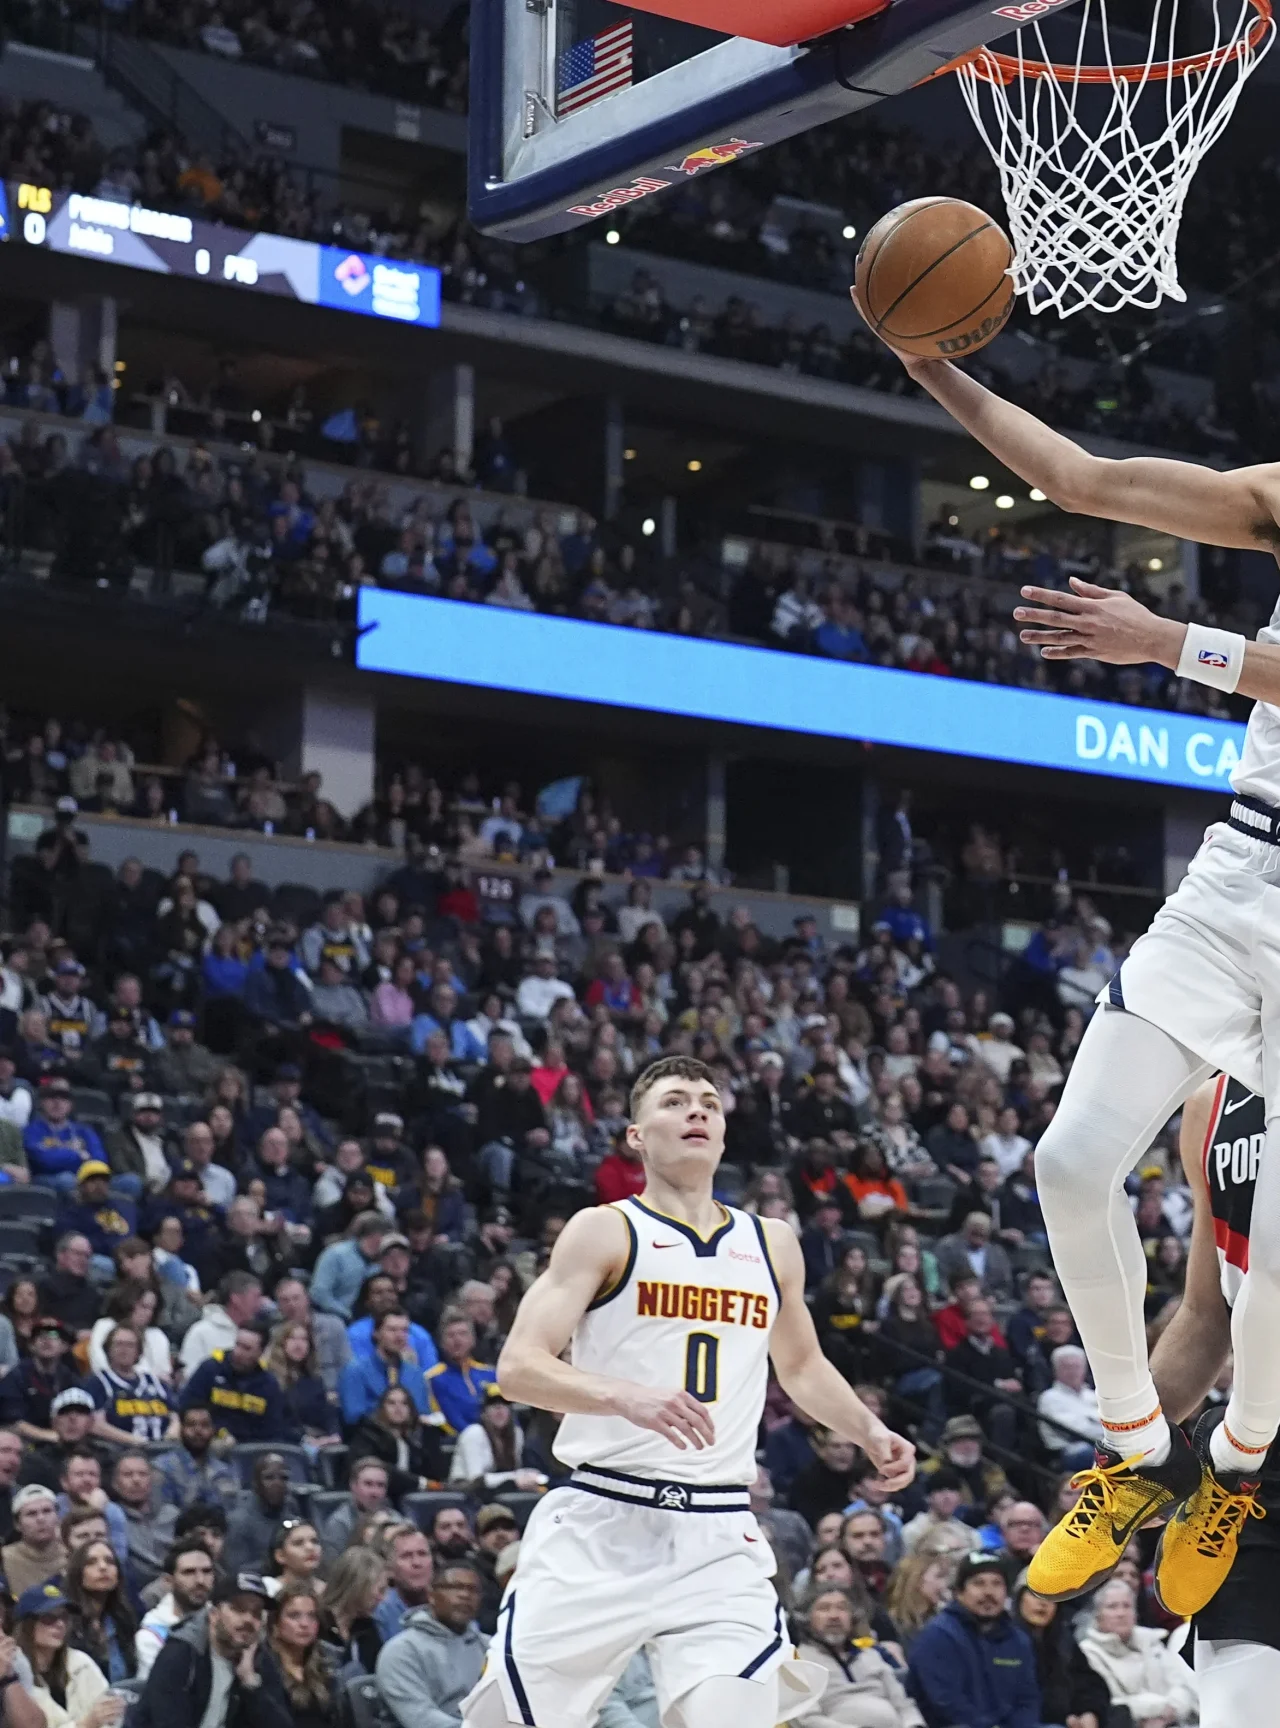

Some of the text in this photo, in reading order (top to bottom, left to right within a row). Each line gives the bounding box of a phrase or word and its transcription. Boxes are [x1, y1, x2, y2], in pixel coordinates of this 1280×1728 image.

[24, 212, 46, 244] 0
[1075, 714, 1169, 770] DAN
[636, 1280, 769, 1329] NUGGETS
[684, 1331, 720, 1405] 0
